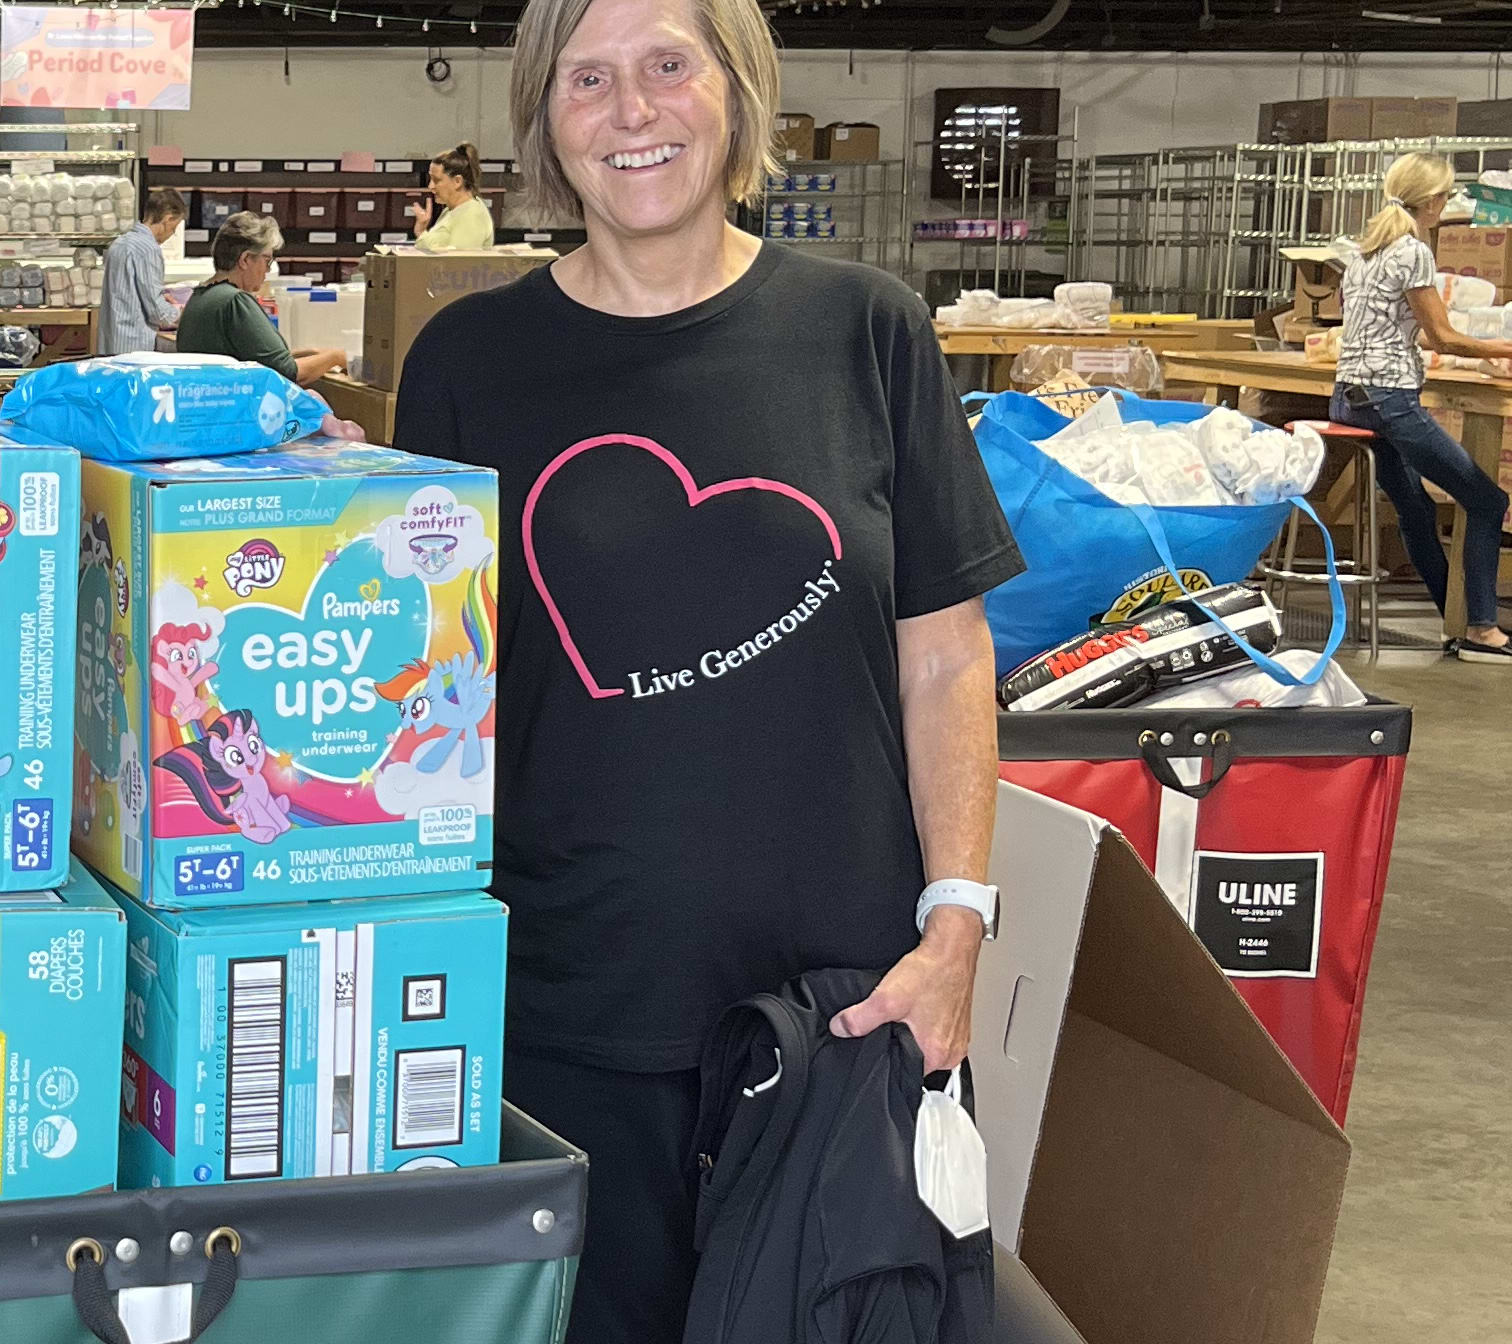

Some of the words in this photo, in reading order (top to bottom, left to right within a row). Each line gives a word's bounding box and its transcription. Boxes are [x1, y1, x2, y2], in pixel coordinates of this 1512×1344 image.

[28, 50, 103, 73] Period
[109, 52, 166, 74] Cove
[197, 497, 253, 512] LARGEST
[255, 496, 282, 509] SIZE
[205, 512, 234, 525] PLUS
[237, 510, 284, 524] GRAND
[287, 507, 336, 521] FORMAT
[413, 503, 441, 517] soft
[224, 555, 286, 597] PONY
[323, 592, 400, 620] Pampers
[628, 668, 695, 698] Live
[700, 567, 840, 678] Generously
[20, 612, 36, 691] UNDERWEAR
[92, 596, 106, 721] easy
[241, 627, 374, 675] easy
[274, 679, 377, 726] ups
[18, 693, 34, 749] TRAINING
[302, 741, 378, 757] underwear
[312, 729, 368, 746] training
[23, 759, 44, 790] 46
[423, 823, 471, 834] LEAKPROOF
[289, 847, 341, 867] TRAINING
[343, 842, 415, 862] UNDERWEAR
[252, 859, 281, 881] 46
[1218, 881, 1297, 906] ULINE
[28, 950, 49, 980] 58
[49, 937, 67, 993] DIAPERS
[66, 928, 85, 1000] COUCHES
[216, 1005, 226, 1023] 00
[215, 1035, 226, 1080] 37000
[376, 1027, 389, 1069] VENDU
[9, 1052, 20, 1082] peau
[471, 1056, 484, 1090] SOLD
[6, 1100, 18, 1113] de
[153, 1089, 162, 1117] 6
[375, 1069, 388, 1115] COMME
[470, 1093, 481, 1109] AS
[18, 1116, 29, 1137] 100
[214, 1092, 225, 1137] 71512
[469, 1112, 481, 1133] SET
[6, 1116, 18, 1175] protection
